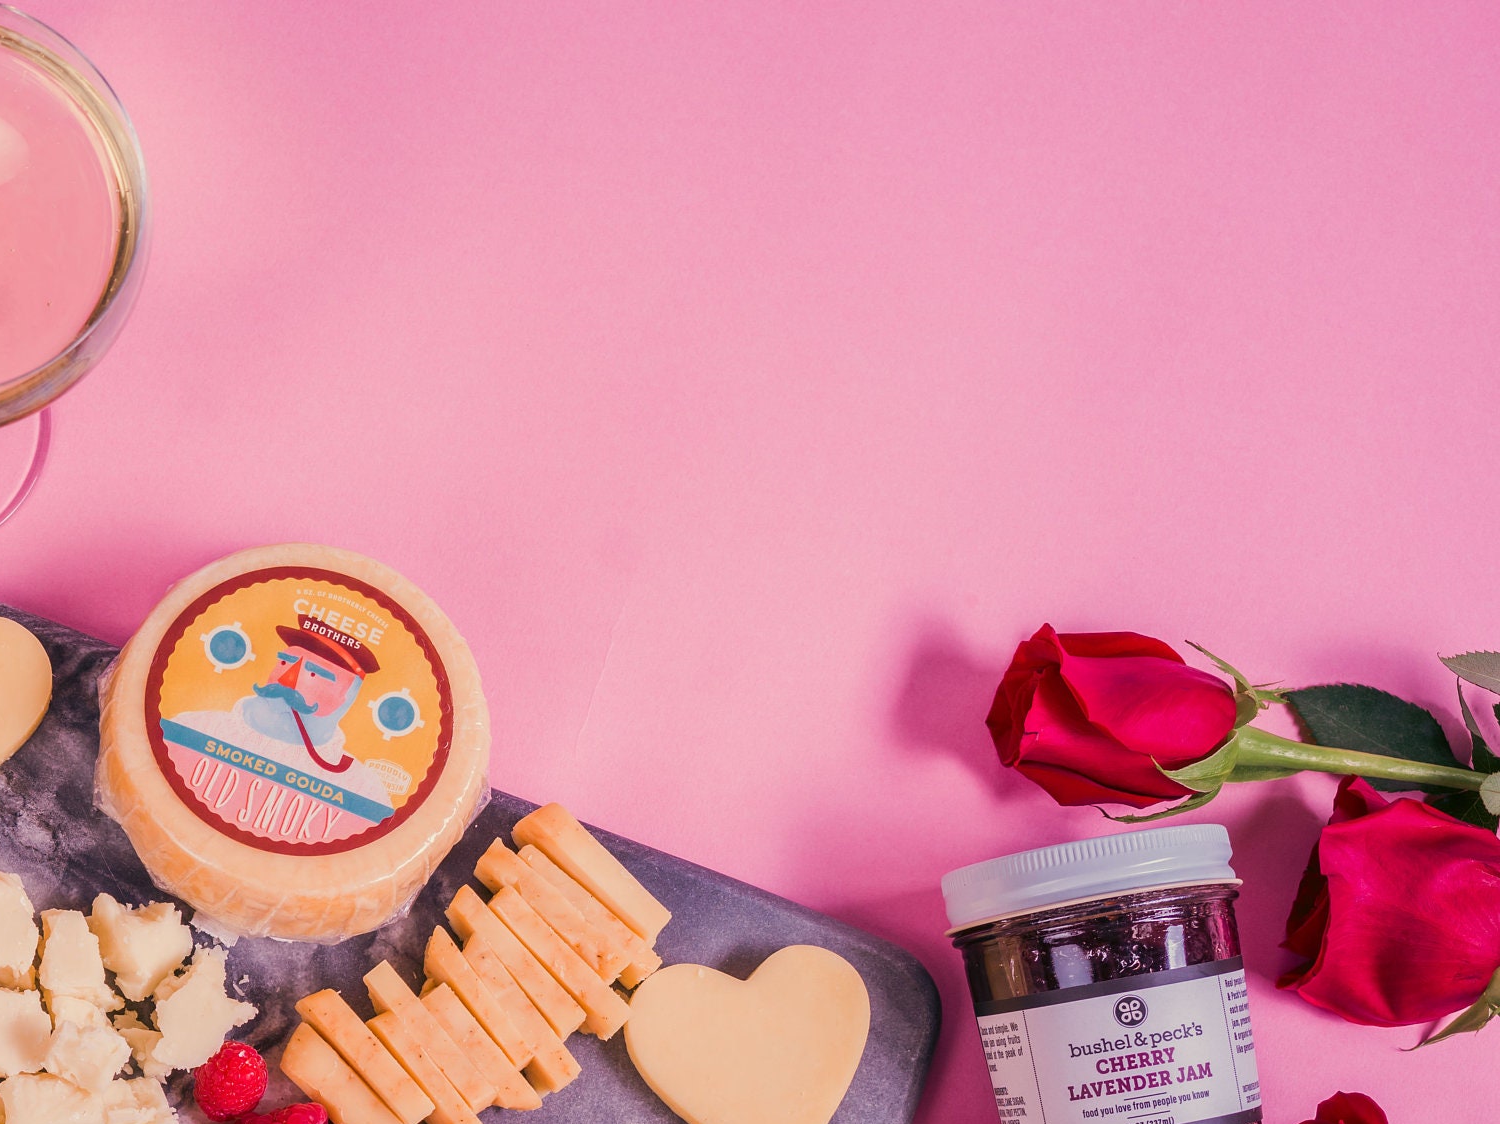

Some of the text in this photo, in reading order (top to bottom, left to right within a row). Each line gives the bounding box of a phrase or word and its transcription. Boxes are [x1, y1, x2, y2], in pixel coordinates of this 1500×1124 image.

[294, 598, 384, 645] CHEESE
[303, 620, 361, 649] BROTHERS
[204, 740, 344, 805] SMOKED GOUDA
[190, 757, 344, 840] OLD SMOKY
[1068, 1022, 1203, 1058] bushel & peck's
[1096, 1047, 1175, 1074] CHERRY
[1068, 1062, 1213, 1101] LAVENDER JAM
[1082, 1090, 1210, 1118] food you love from people you know
